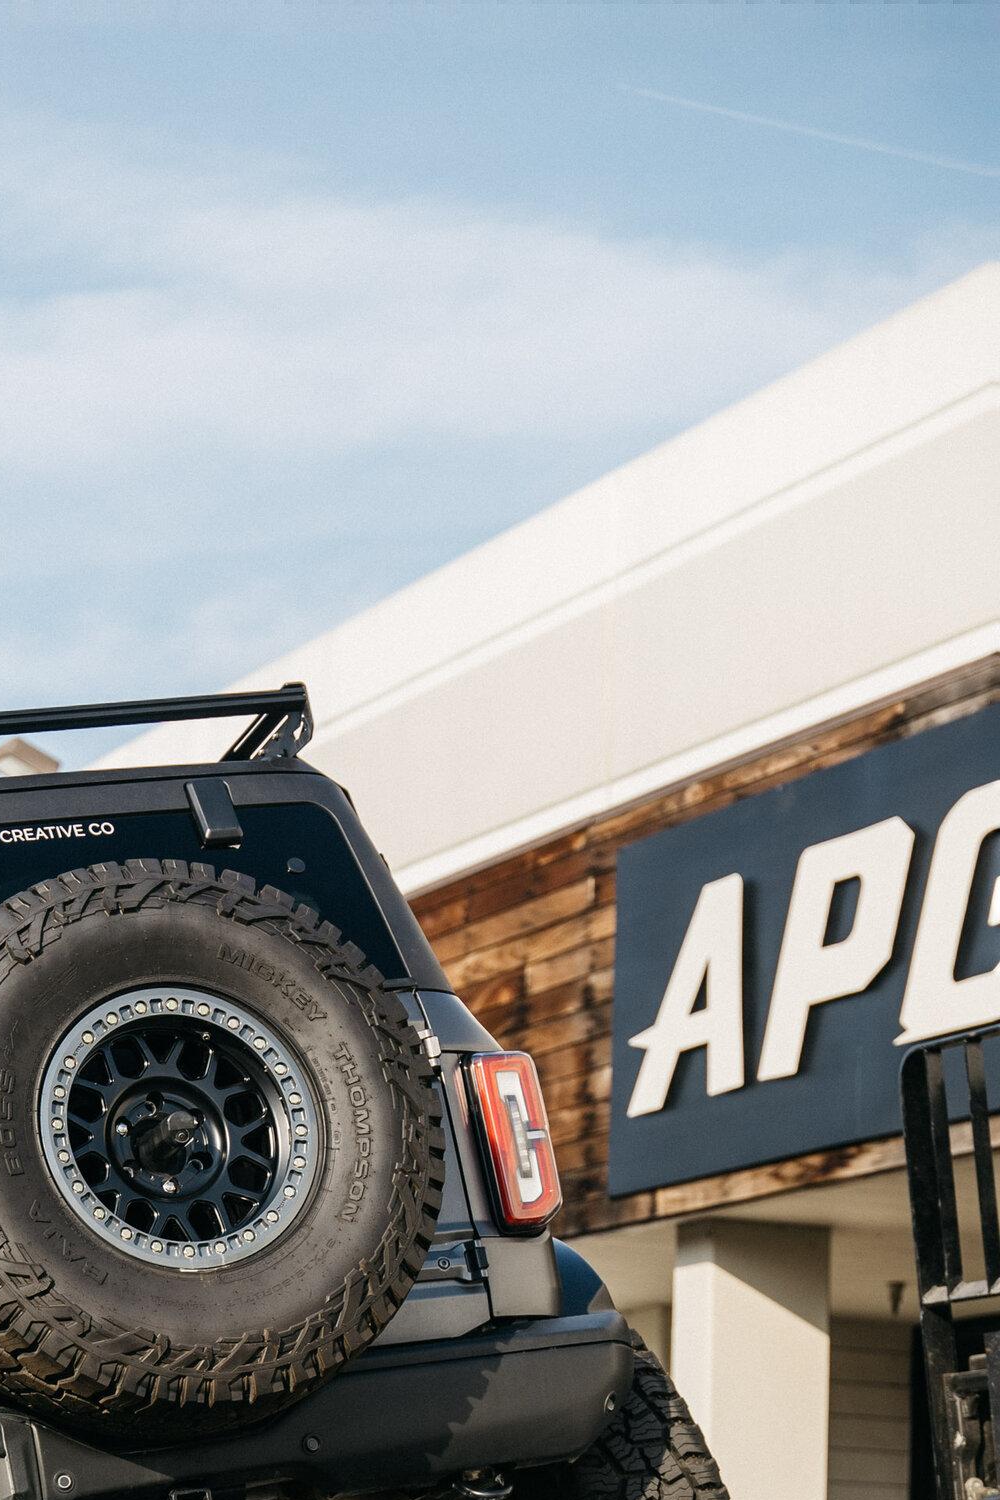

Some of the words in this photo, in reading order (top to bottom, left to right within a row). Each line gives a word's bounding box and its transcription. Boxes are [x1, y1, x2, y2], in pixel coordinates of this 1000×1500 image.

[0, 823, 86, 844] CREATIVE
[88, 821, 116, 836] CO
[216, 942, 329, 1022] MICKEY
[334, 1040, 372, 1223] THOMPSON
